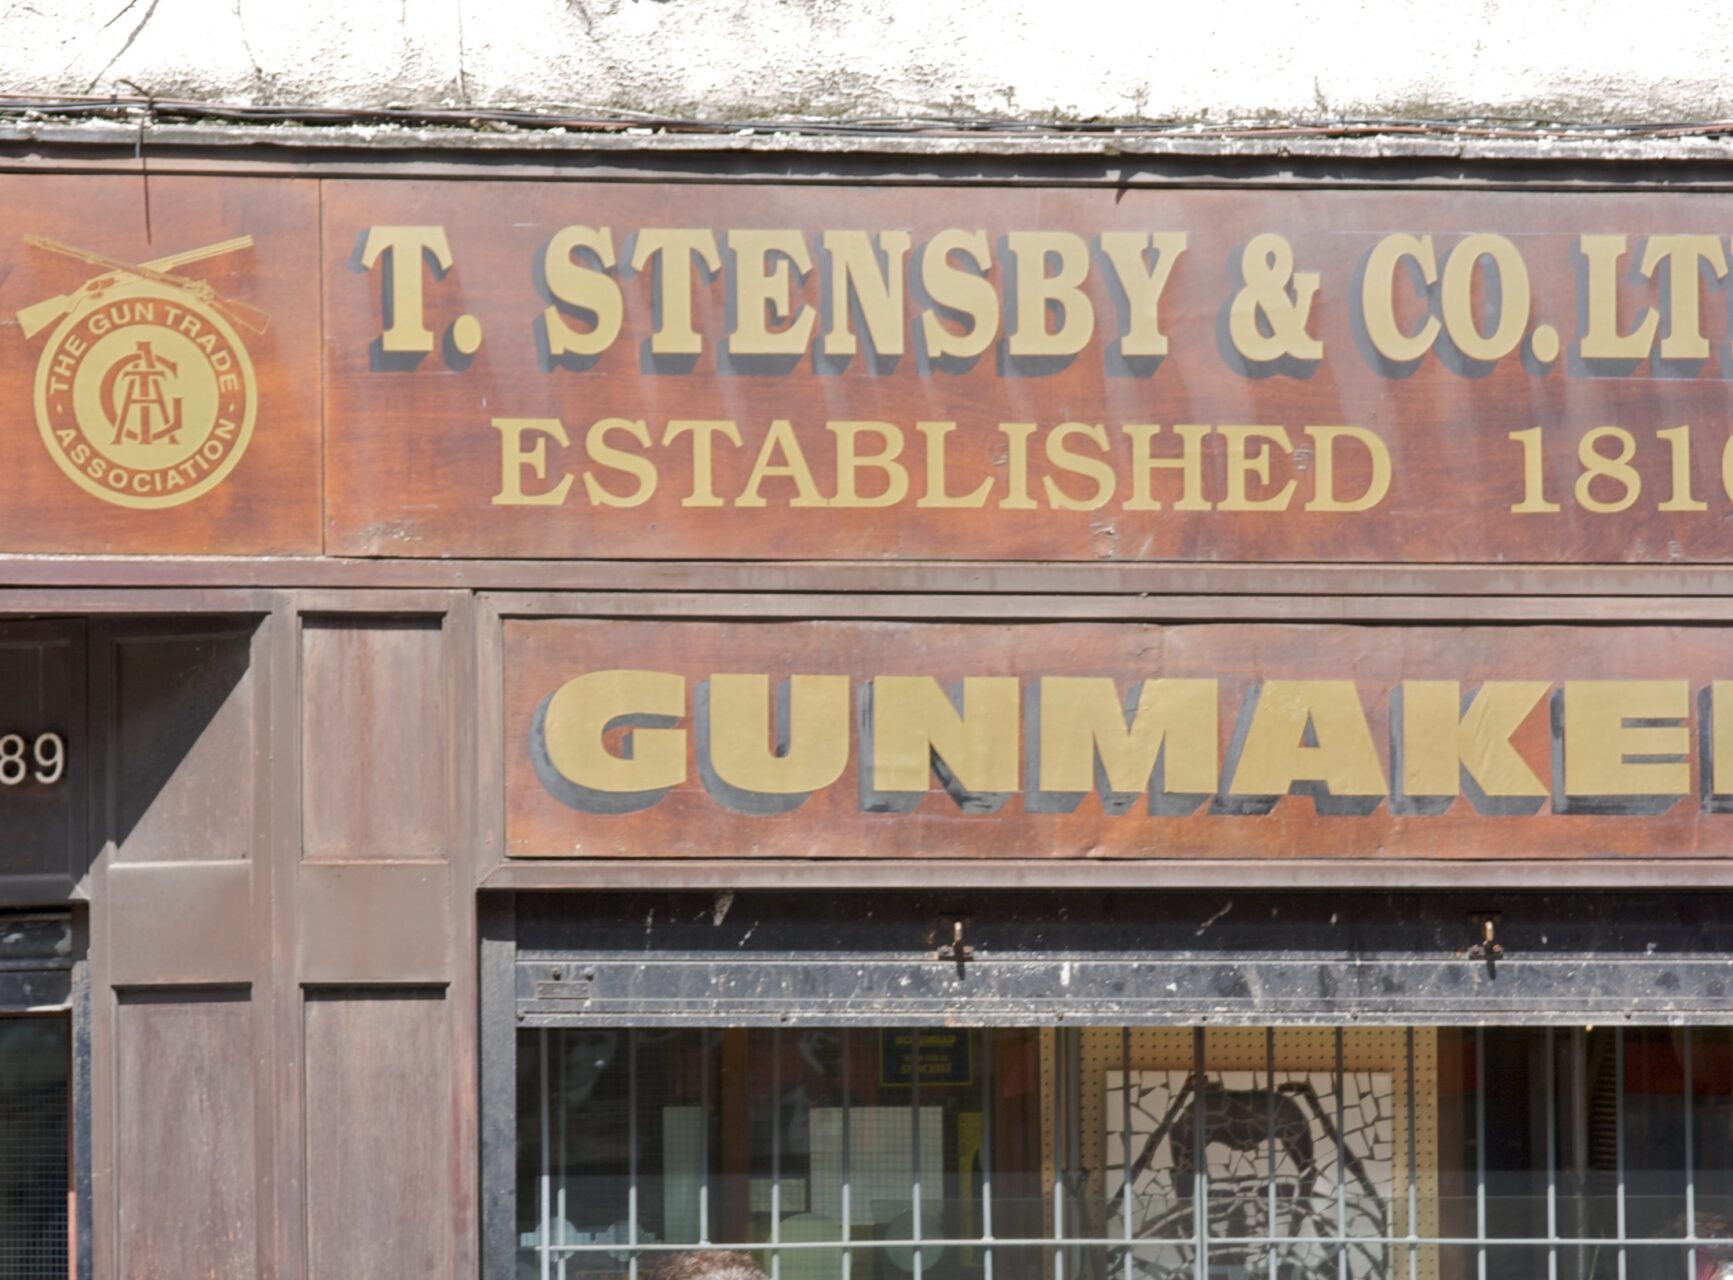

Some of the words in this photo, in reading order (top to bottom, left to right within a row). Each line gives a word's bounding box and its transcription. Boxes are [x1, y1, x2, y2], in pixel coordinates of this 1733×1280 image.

[361, 225, 482, 354] T.
[543, 225, 1189, 358] STENSBY
[1229, 233, 1324, 362] &
[1579, 233, 1733, 360] LT
[49, 333, 88, 395] THE
[87, 302, 155, 336] GUN
[163, 304, 240, 393] TRADE
[56, 417, 237, 494] ASSOCIATION
[490, 417, 1393, 512] ESTABLISHED
[1508, 425, 1733, 513] 181
[544, 669, 1733, 799] GUNMAKE
